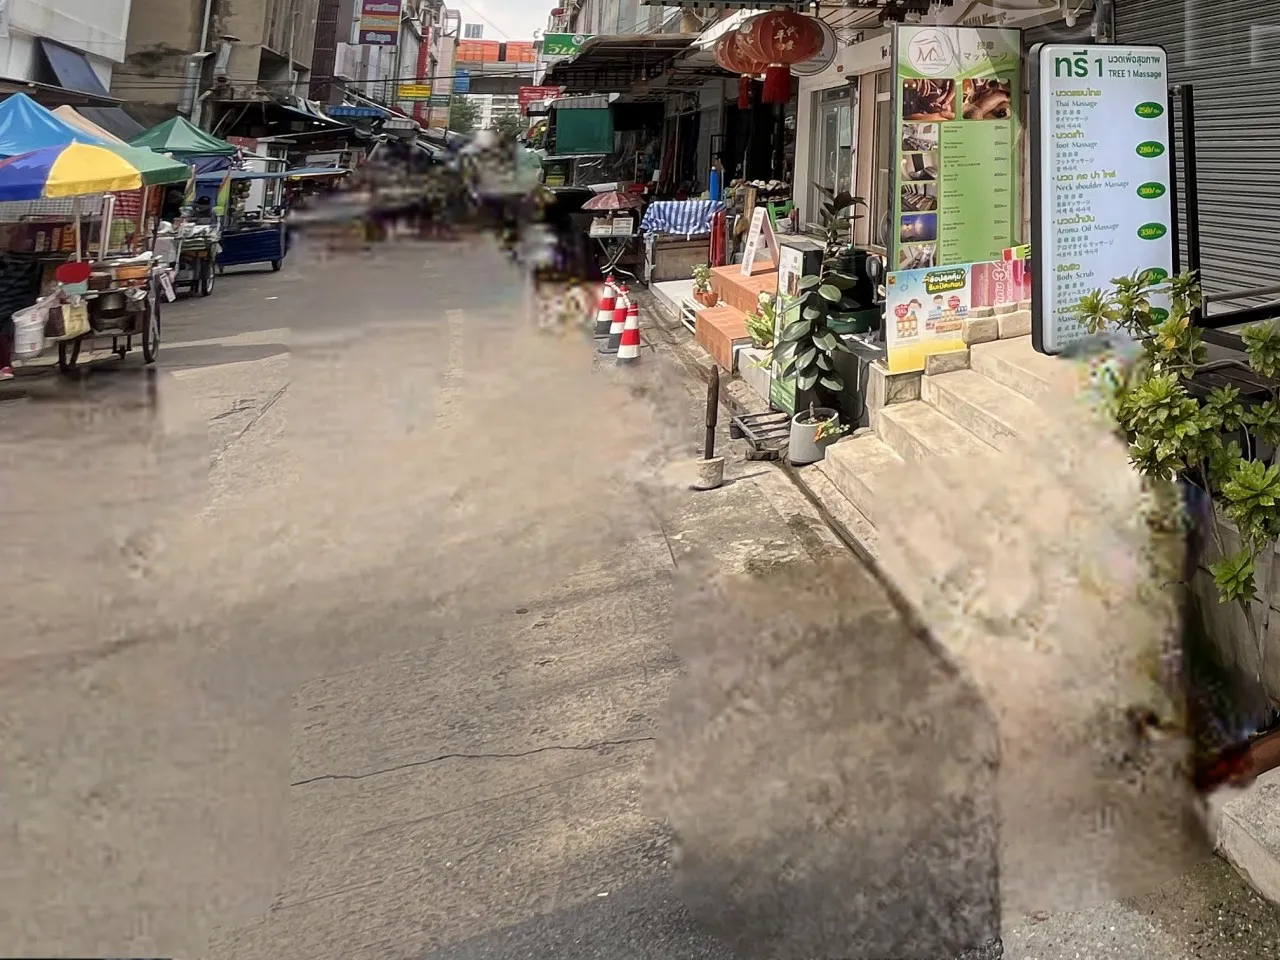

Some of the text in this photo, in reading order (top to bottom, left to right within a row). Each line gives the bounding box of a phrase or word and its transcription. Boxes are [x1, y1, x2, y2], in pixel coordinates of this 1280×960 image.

[963, 51, 1008, 62] マッサージ
[1108, 51, 1160, 66] นวดเพื่อสุขภาพ
[1055, 50, 1103, 78] ทรี 1
[1108, 69, 1162, 79] TREE 1 Massage
[1076, 182, 1102, 190] shoulder
[1081, 224, 1092, 232] Oil
[1057, 270, 1094, 281] Body Scrub
